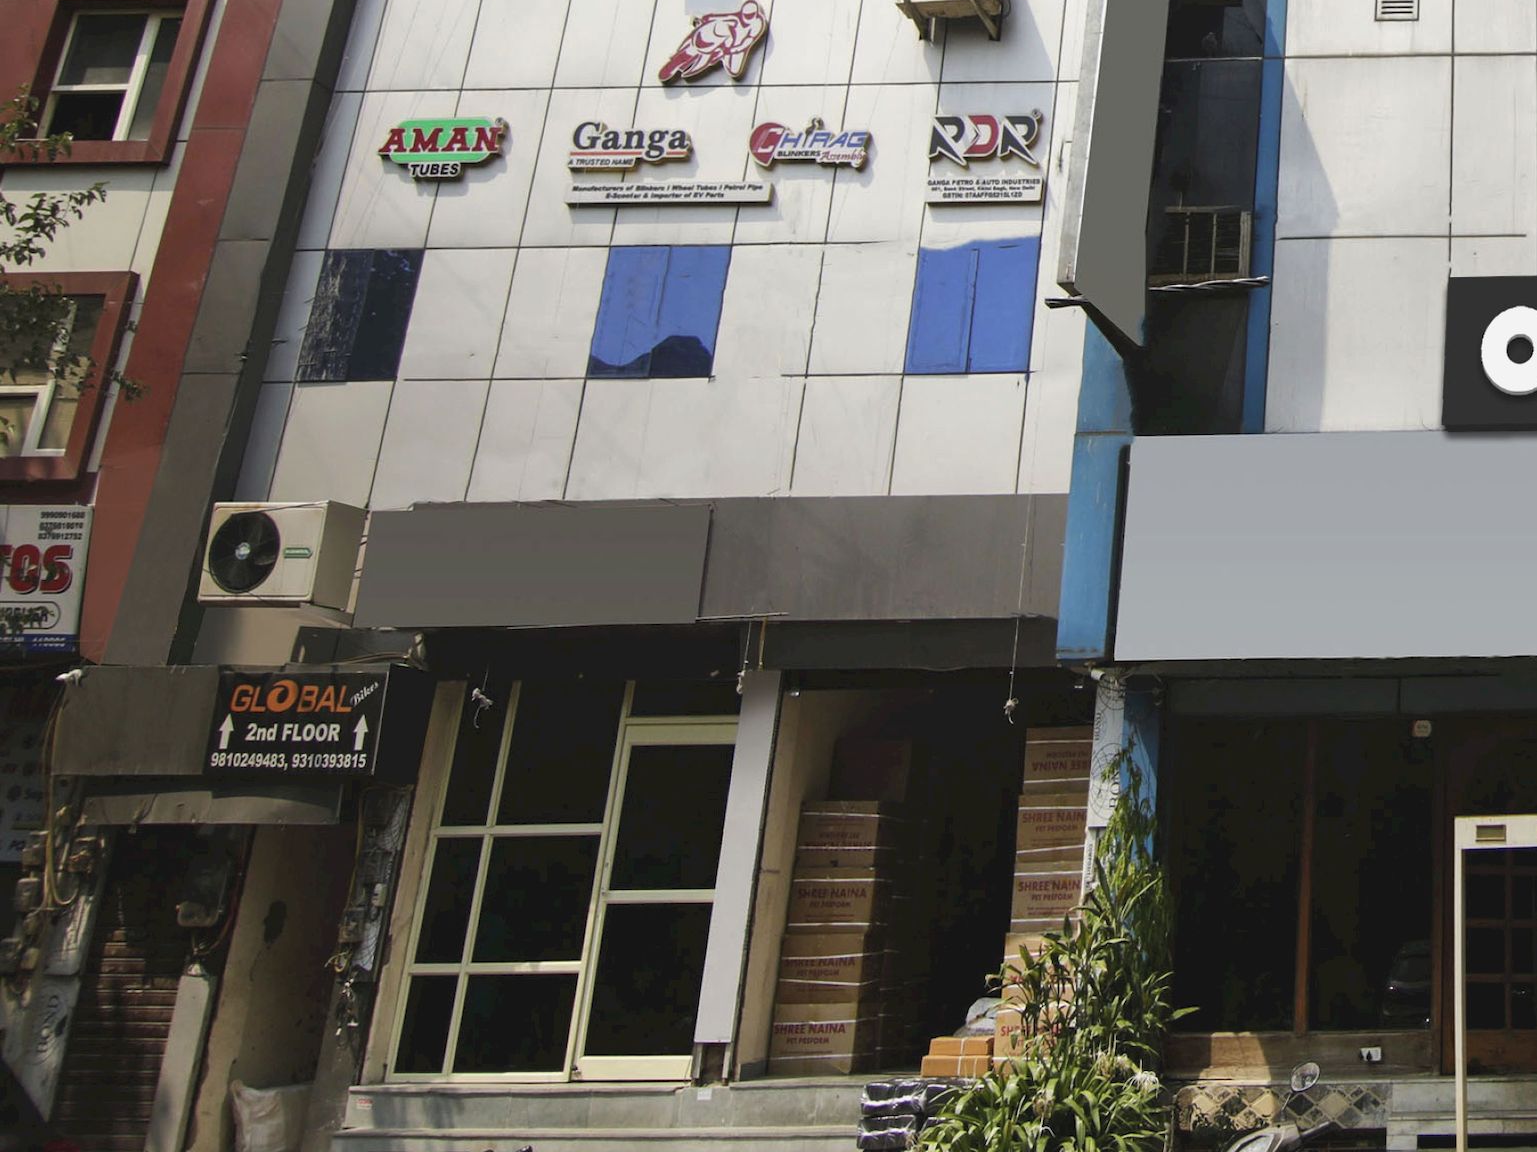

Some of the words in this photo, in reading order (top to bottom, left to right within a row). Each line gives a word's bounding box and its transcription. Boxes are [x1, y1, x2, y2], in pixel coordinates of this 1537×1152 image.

[378, 127, 501, 153] AMAN
[573, 121, 689, 159] Ganga
[929, 115, 1038, 165] RDR
[576, 158, 610, 166] TRUSTED
[612, 158, 634, 166] NAME
[410, 163, 459, 176] TUBES
[0, 544, 74, 594] OS
[230, 679, 353, 714] GLOBAL
[245, 723, 278, 742] 2nd
[282, 723, 341, 742] FLOOR
[1022, 813, 1053, 823] SHREE
[1056, 811, 1086, 822] NAIN
[1018, 881, 1050, 892] SHREE
[1052, 879, 1081, 891] NAIN
[831, 887, 867, 898] NAINA
[818, 956, 856, 967] NAINA
[774, 1023, 807, 1035] SHREE
[809, 1022, 846, 1035] NAINA
